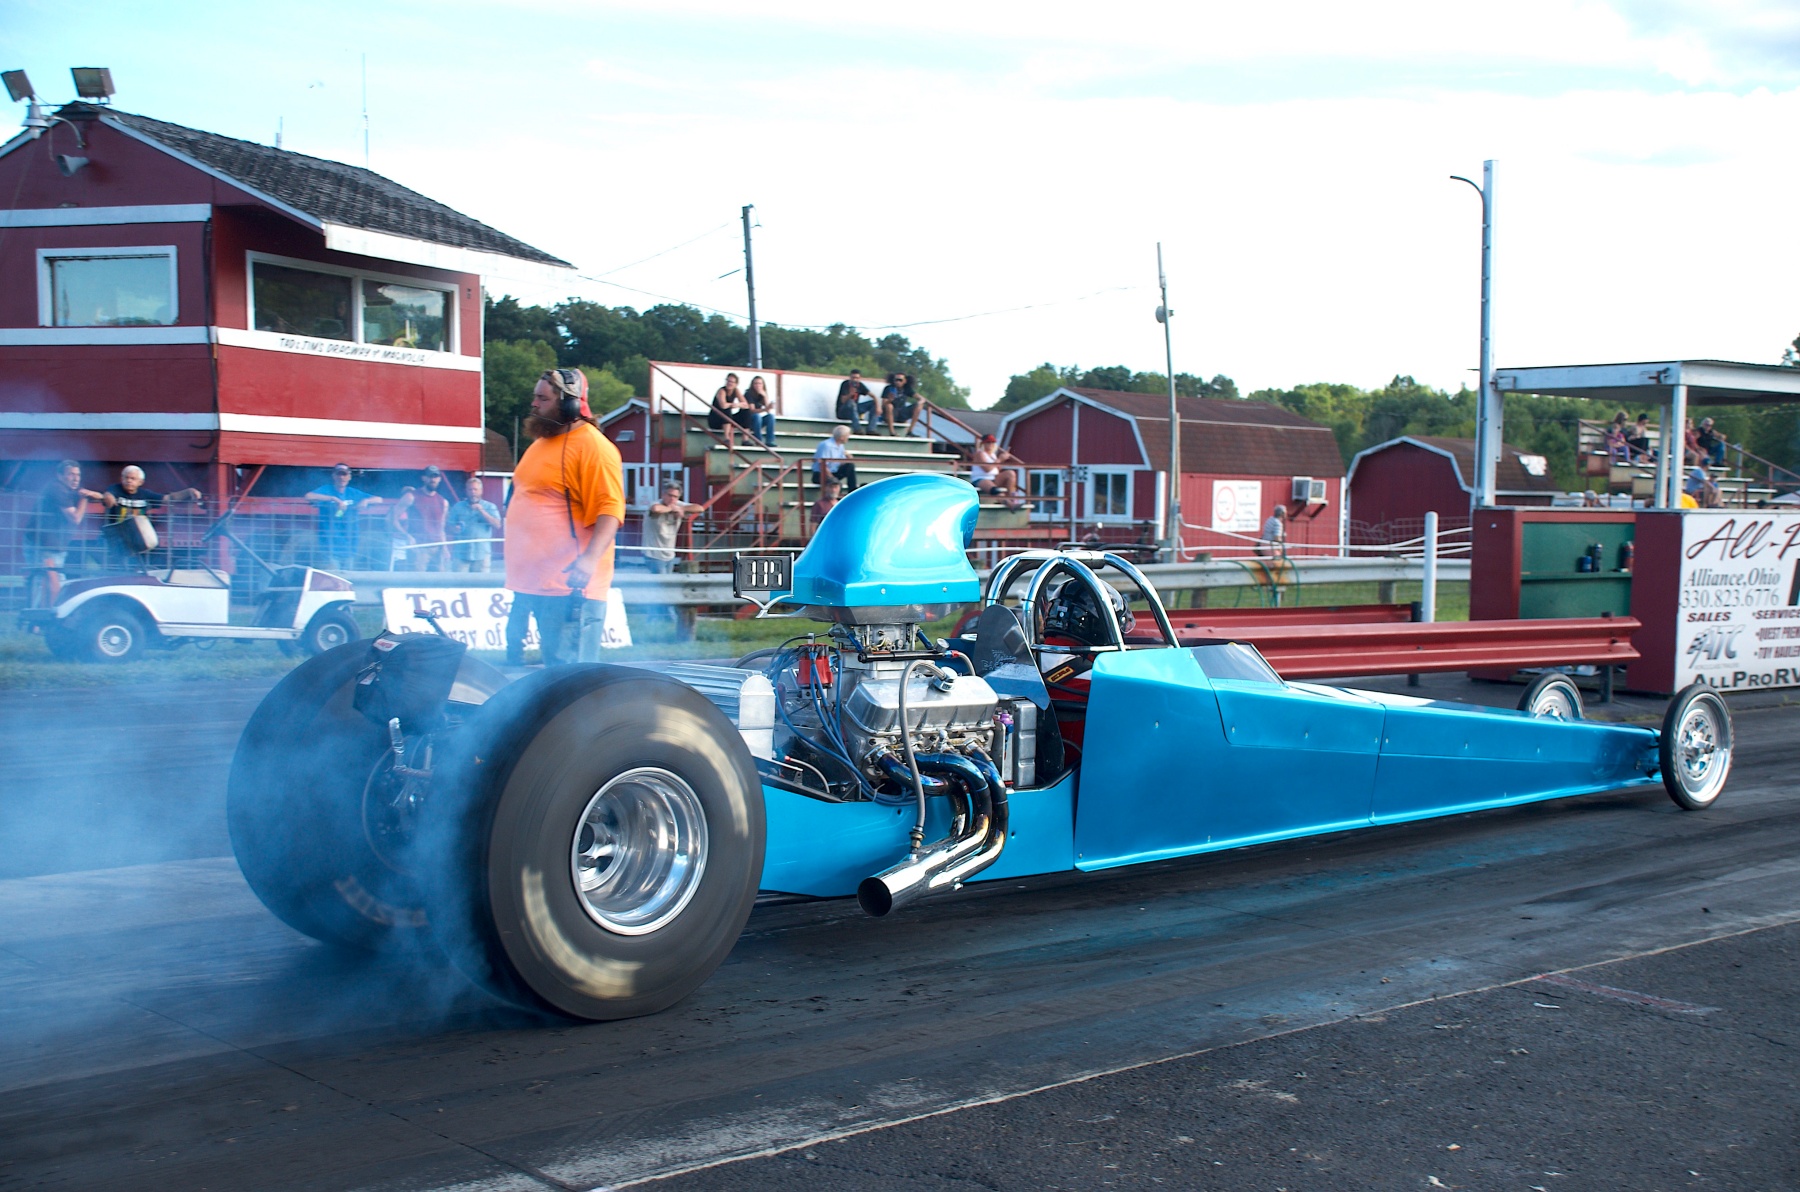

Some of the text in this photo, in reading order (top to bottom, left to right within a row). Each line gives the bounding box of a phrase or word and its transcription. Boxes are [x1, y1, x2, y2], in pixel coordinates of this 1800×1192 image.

[406, 592, 513, 618] Tad &
[1680, 588, 1780, 608] 330.823.6776
[1687, 611, 1732, 622] SALES
[485, 621, 503, 646] of
